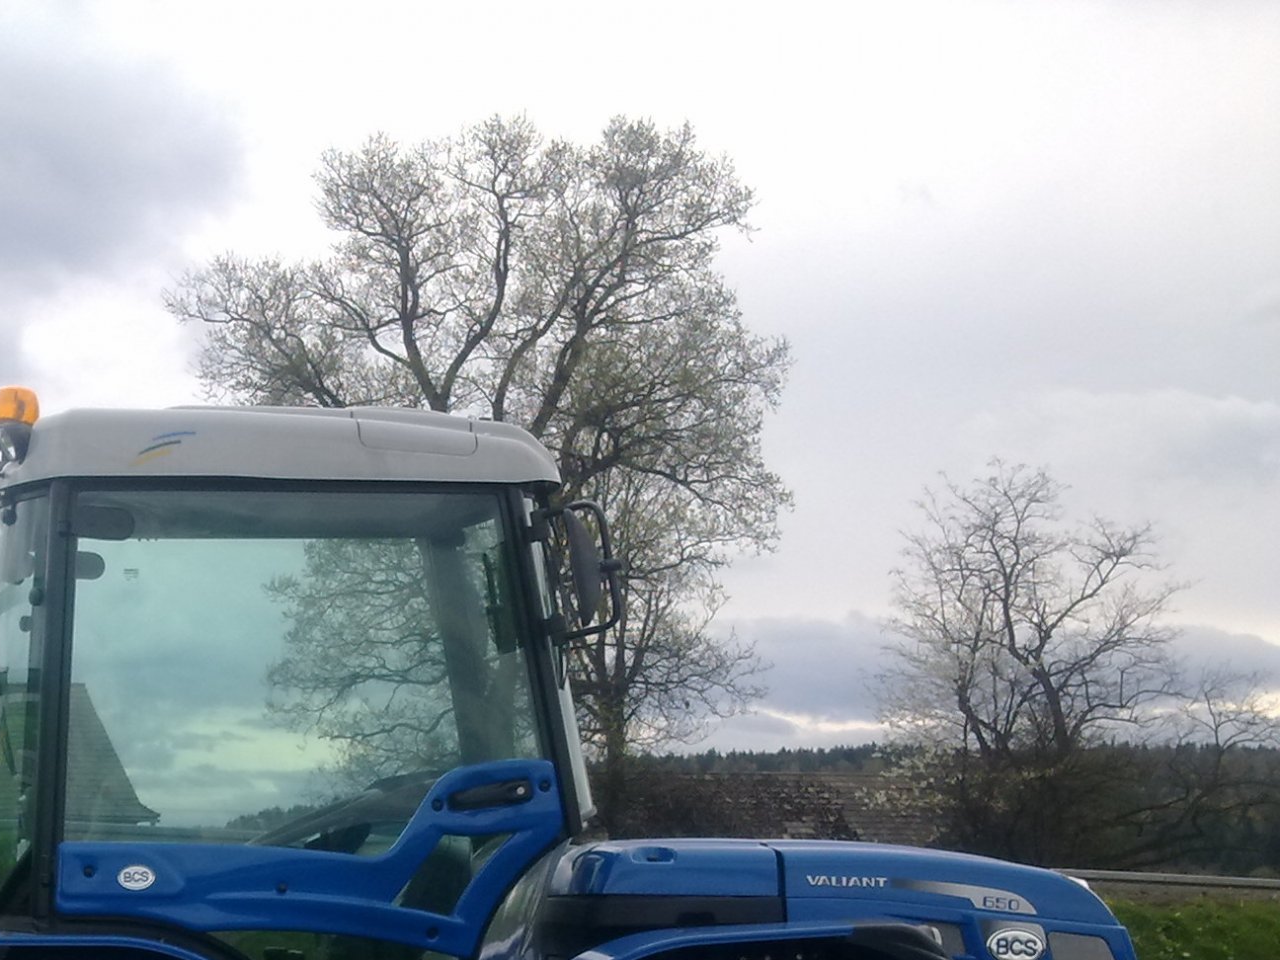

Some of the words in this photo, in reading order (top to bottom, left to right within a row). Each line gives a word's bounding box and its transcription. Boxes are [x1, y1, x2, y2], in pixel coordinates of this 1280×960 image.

[123, 870, 150, 883] BCS
[806, 874, 887, 888] VALIANT
[982, 896, 1020, 911] 650
[996, 937, 1038, 957] BCS
